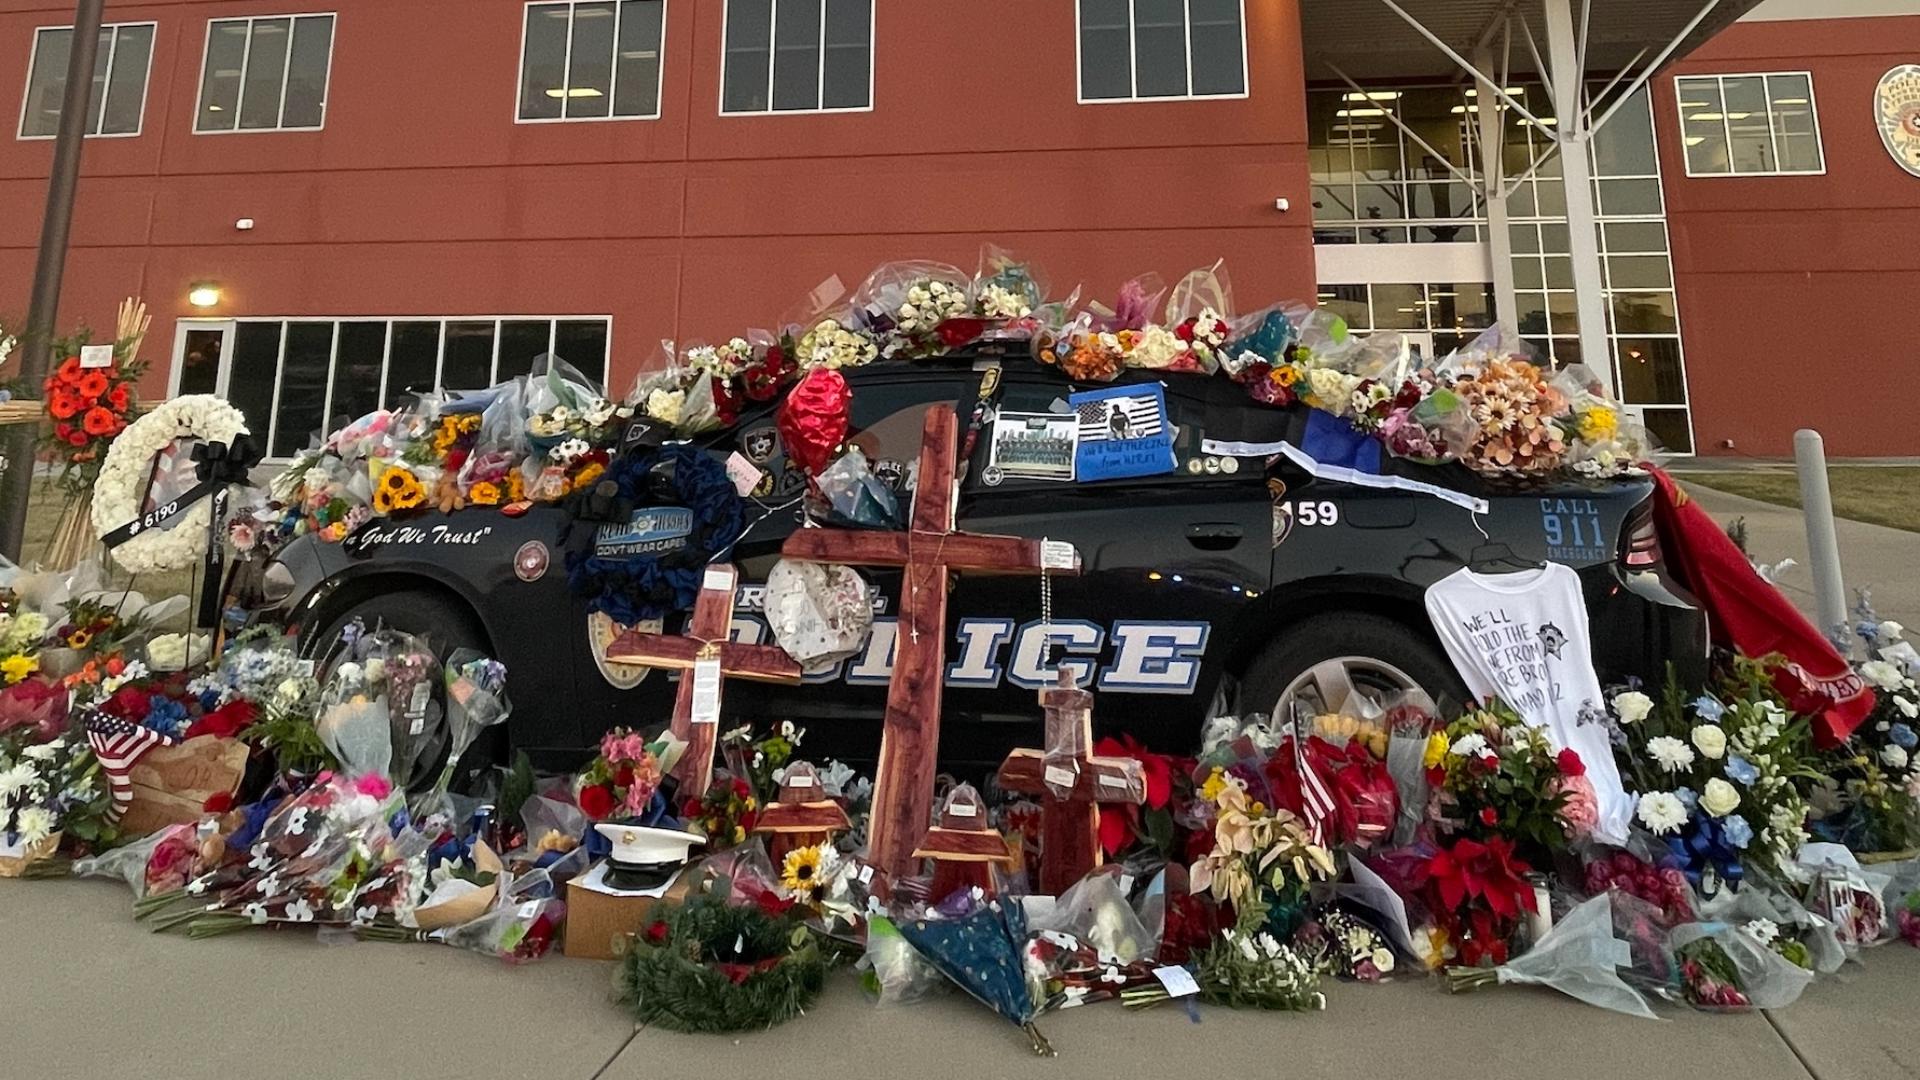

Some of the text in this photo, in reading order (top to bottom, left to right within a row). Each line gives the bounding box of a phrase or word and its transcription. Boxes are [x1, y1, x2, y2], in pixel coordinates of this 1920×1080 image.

[145, 501, 178, 527] 6190
[1541, 498, 1599, 514] CALL
[359, 526, 399, 550] God
[397, 526, 427, 544] We
[431, 525, 492, 544] Trust"
[1543, 514, 1605, 547] 911
[627, 541, 655, 554] WEAR
[656, 536, 687, 551] CAPES
[1463, 608, 1511, 633] WE'LL
[1503, 623, 1534, 643] THE
[1505, 642, 1545, 664] FROM
